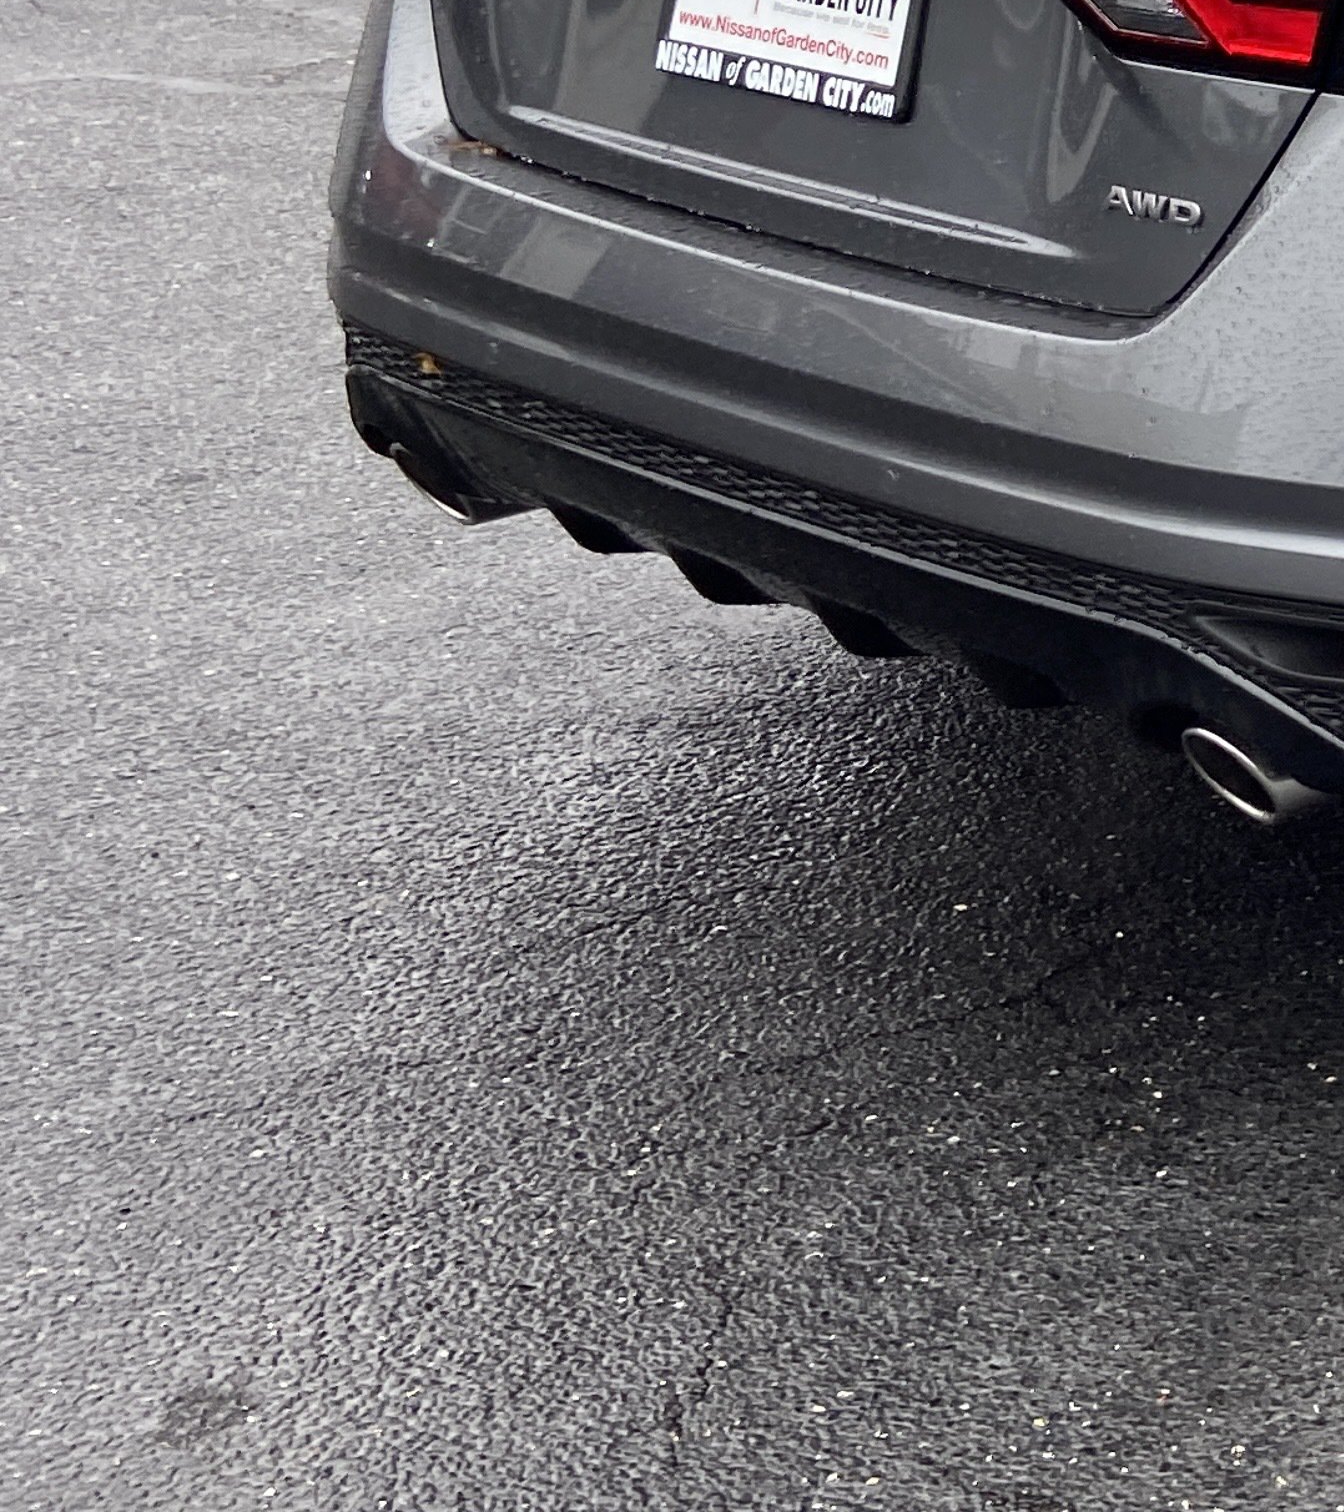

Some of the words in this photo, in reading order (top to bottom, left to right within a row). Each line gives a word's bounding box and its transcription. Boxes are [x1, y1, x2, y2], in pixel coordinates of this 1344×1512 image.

[679, 8, 888, 70] www.NissanofGardenCity.com
[655, 40, 722, 82] NISSAN
[725, 56, 746, 86] of
[745, 59, 819, 103] GARDEN
[822, 76, 895, 118] CITY.com
[1105, 185, 1202, 228] AWD
